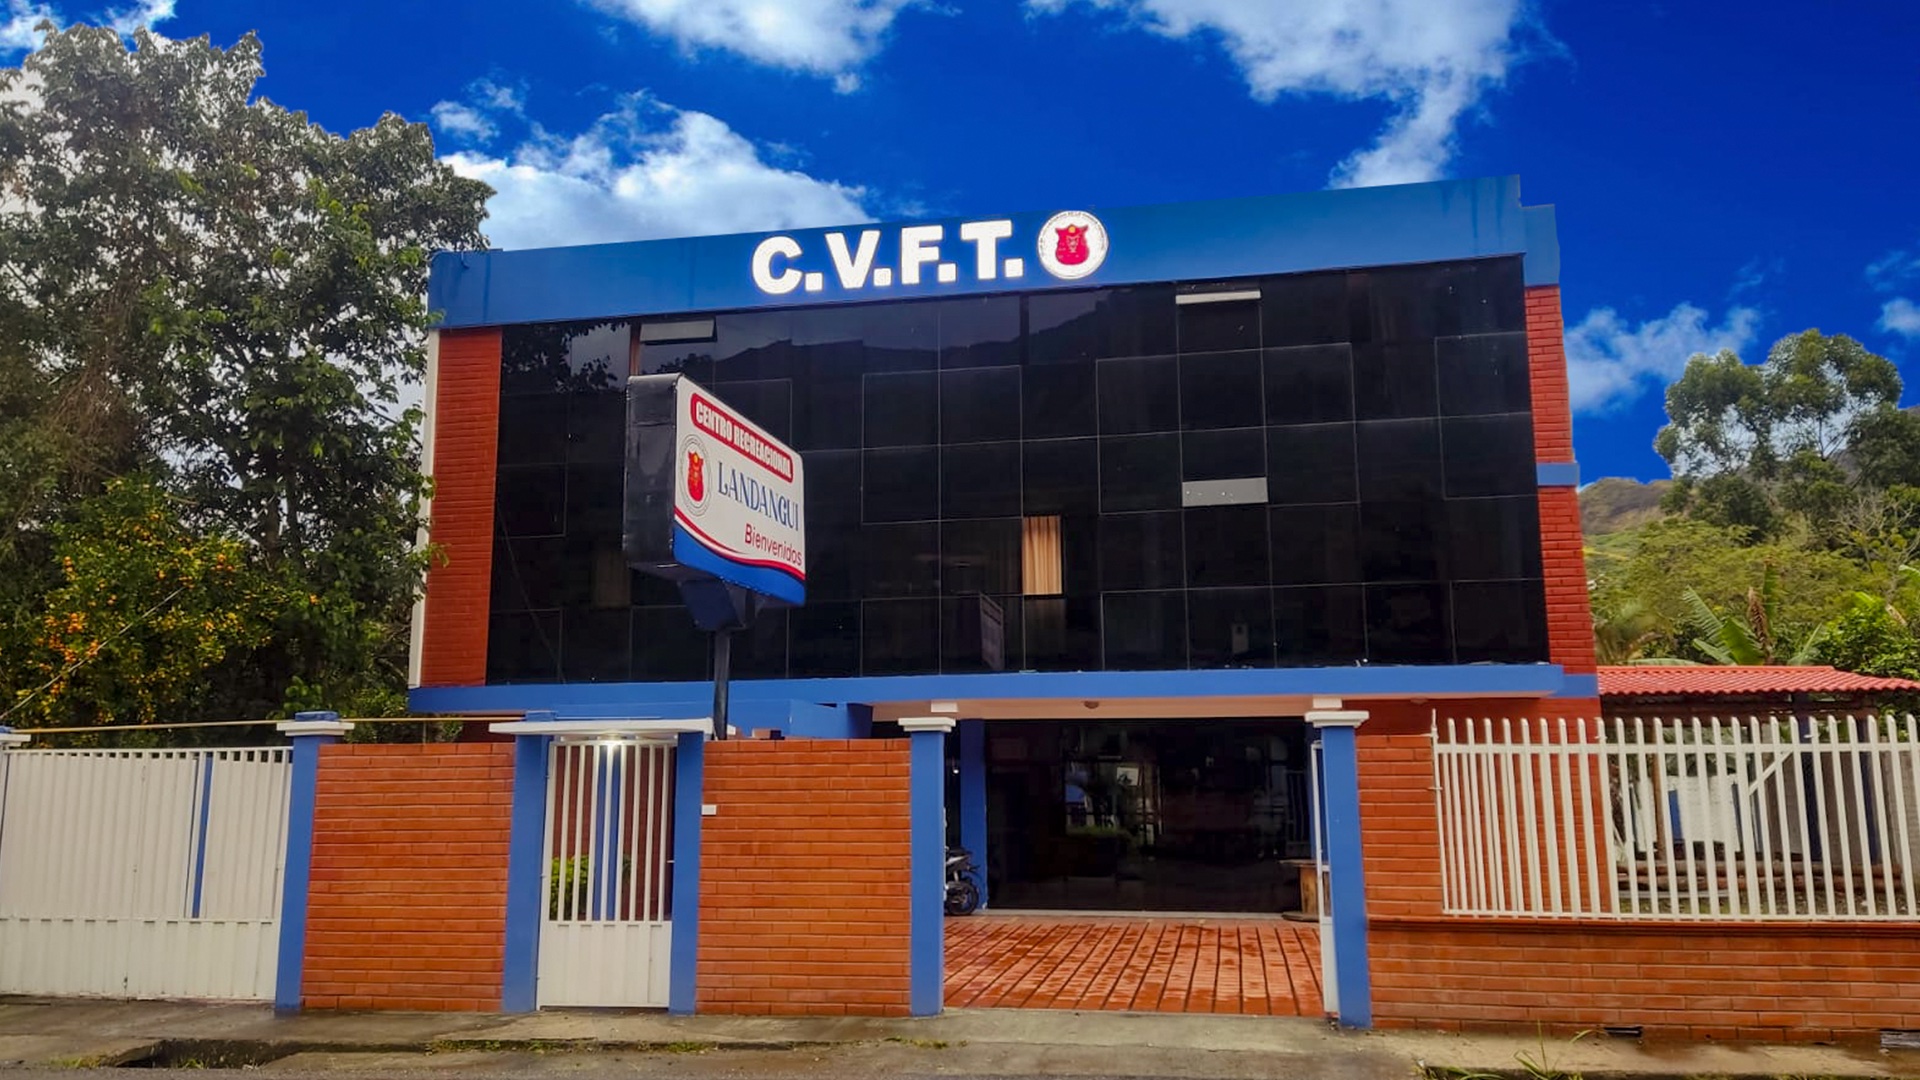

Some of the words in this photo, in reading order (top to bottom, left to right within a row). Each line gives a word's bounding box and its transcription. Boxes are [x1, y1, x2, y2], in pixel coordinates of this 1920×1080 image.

[752, 220, 1023, 294] C.V.F.T.
[696, 401, 733, 444] CENTRO
[733, 424, 791, 478] RECREACIONAL
[718, 461, 798, 531] LANDANGUI
[744, 523, 802, 565] Bienvenidos
